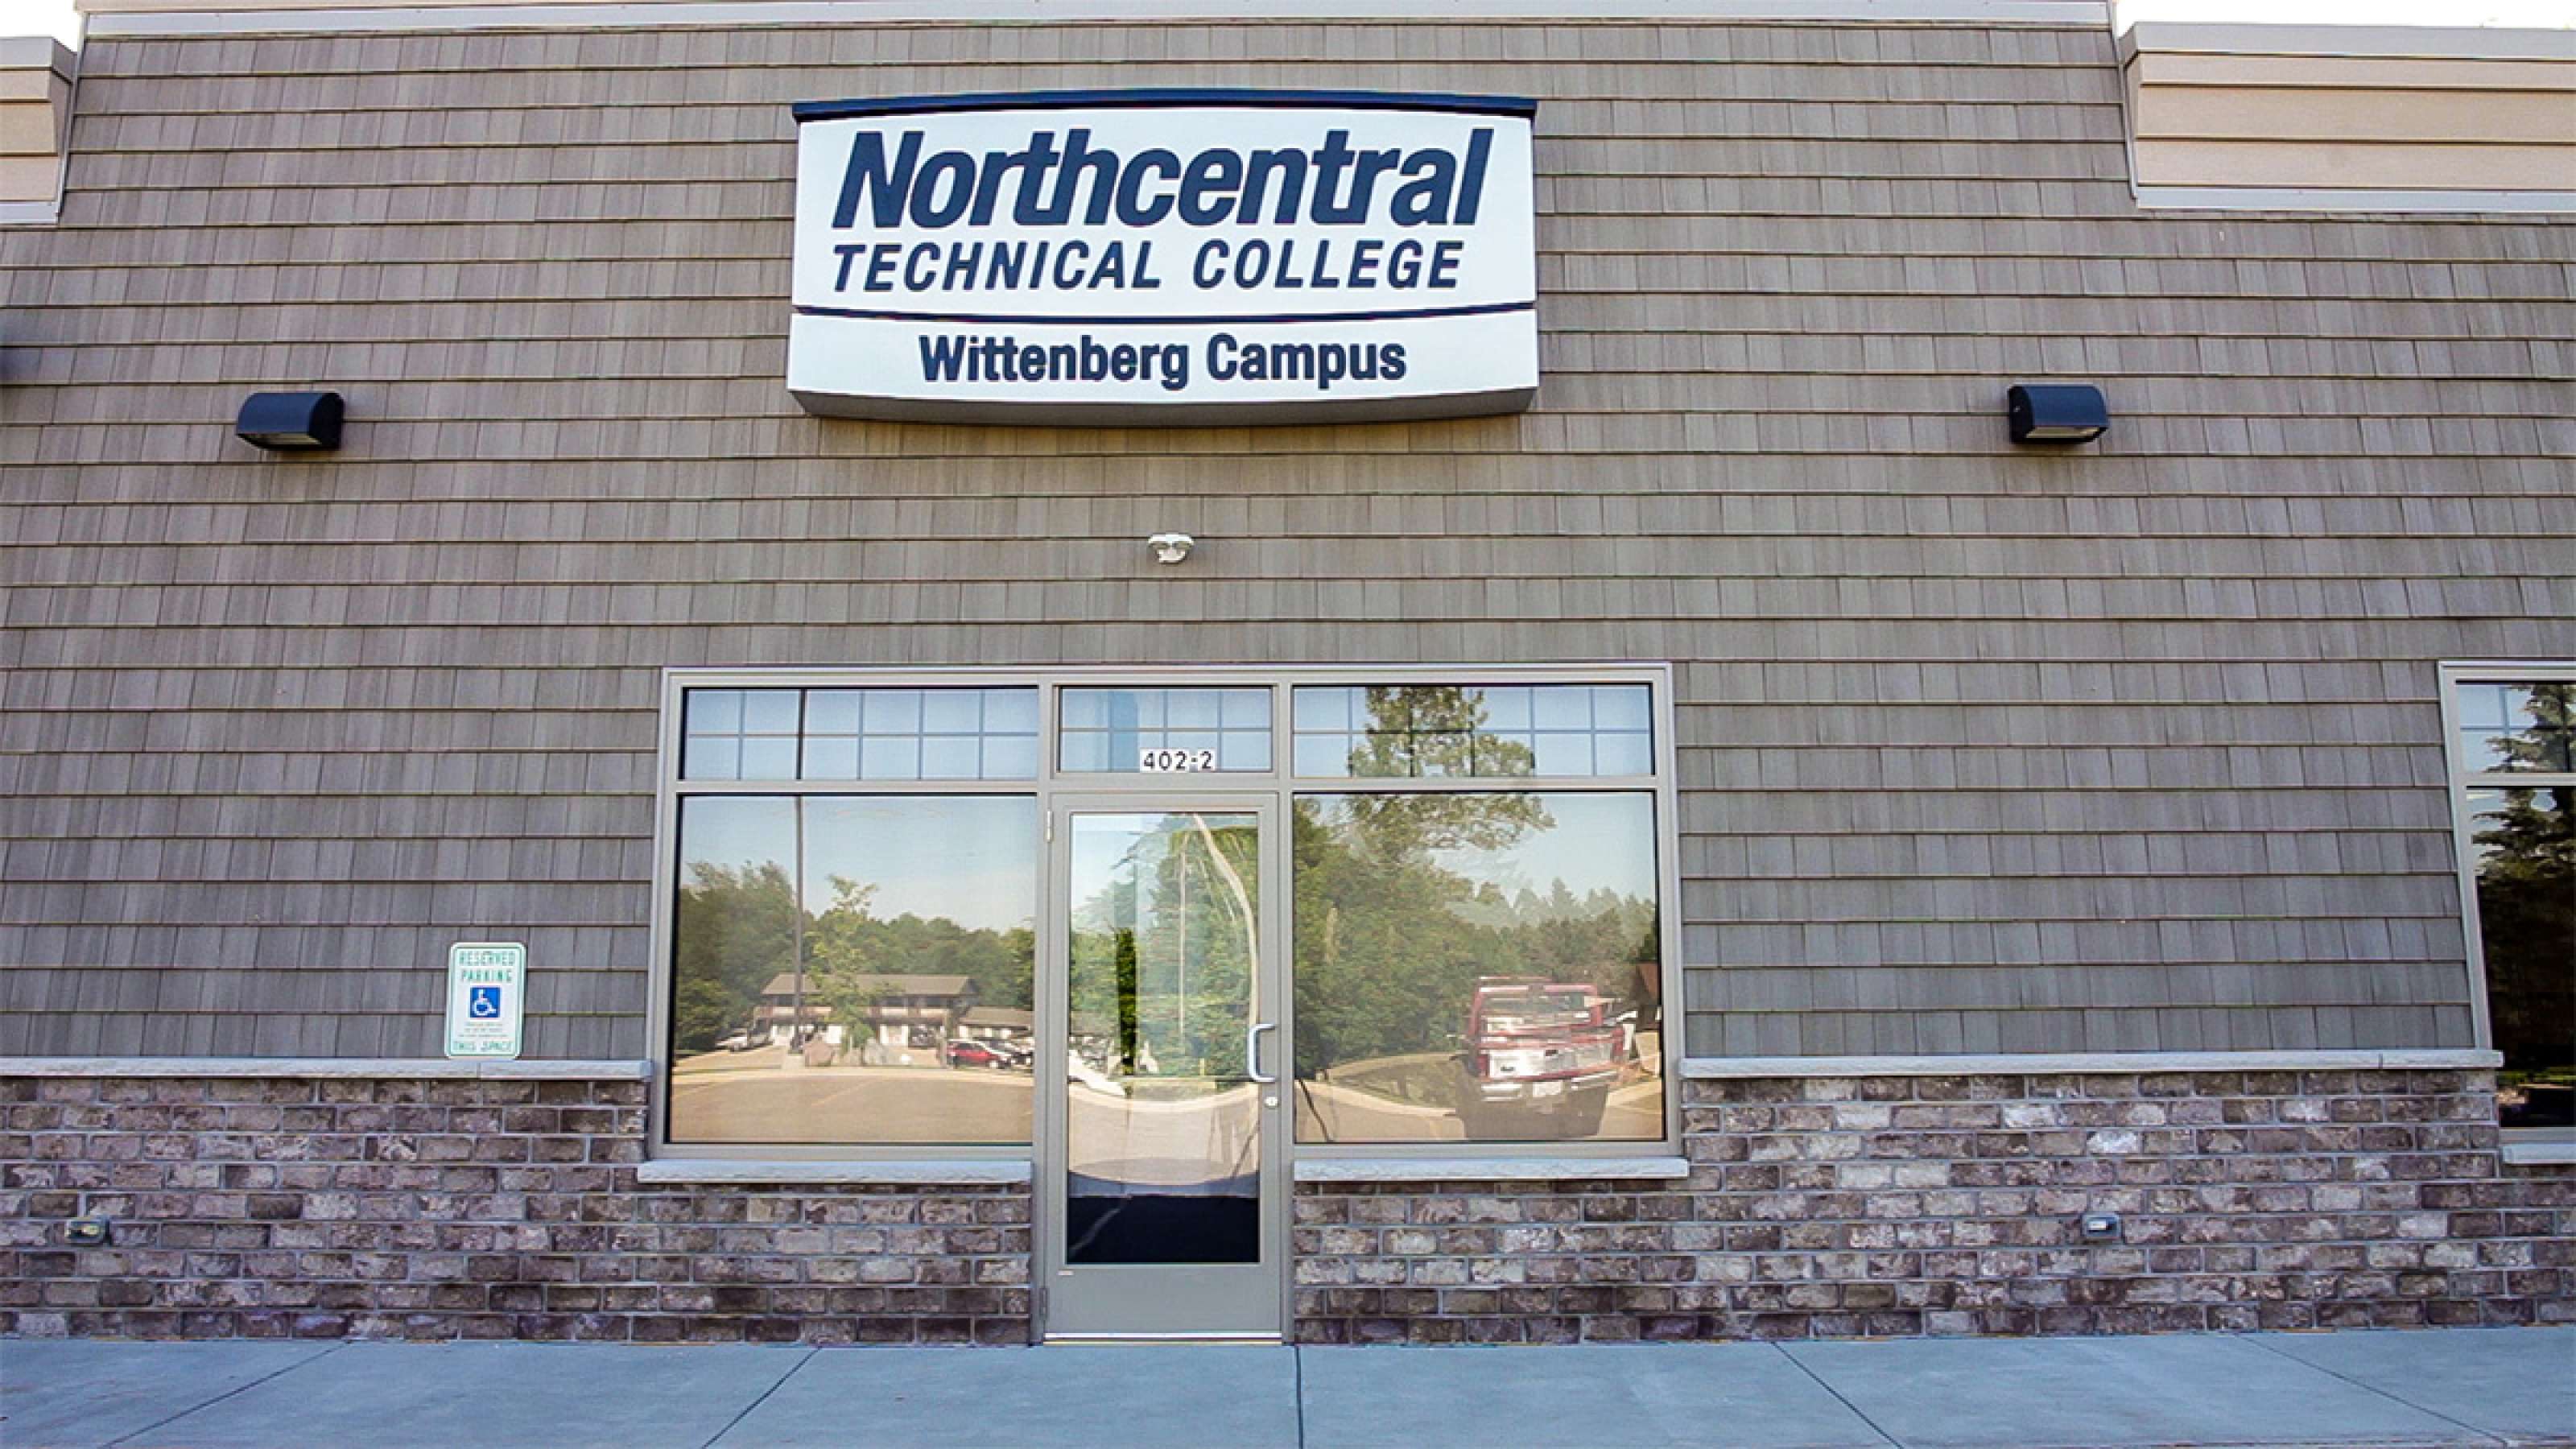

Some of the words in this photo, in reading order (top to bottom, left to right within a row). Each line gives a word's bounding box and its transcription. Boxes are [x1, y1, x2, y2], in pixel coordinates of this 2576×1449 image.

[831, 127, 1495, 229] Northcentral
[833, 239, 1161, 293] TECHNICAL
[1192, 238, 1465, 289] COLLEGE
[918, 332, 1189, 391] Wittenberg
[1205, 332, 1407, 390] Campus
[1142, 749, 1213, 771] 402-2
[459, 950, 516, 967] RESERVED
[460, 968, 513, 983] PARKING
[452, 1040, 477, 1052] THIS
[481, 1039, 514, 1053] SPACE
